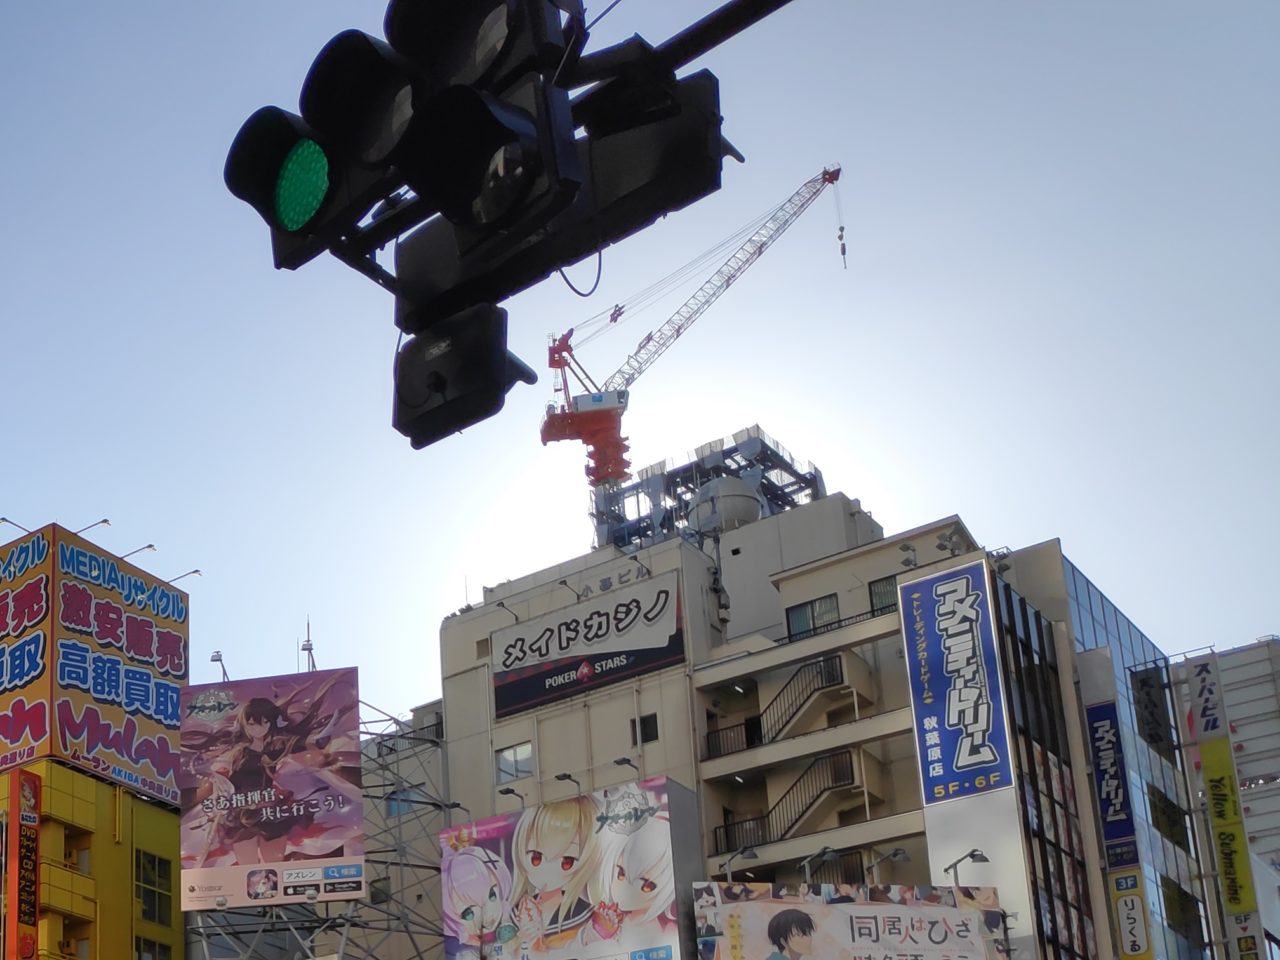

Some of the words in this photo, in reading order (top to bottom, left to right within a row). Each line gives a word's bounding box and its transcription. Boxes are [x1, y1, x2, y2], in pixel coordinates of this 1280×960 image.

[60, 581, 184, 675] 激安販売
[502, 590, 670, 670] メイドカジノ
[57, 640, 181, 728] 高額買取
[545, 671, 577, 689] POKER
[594, 654, 628, 674] STARS
[923, 716, 944, 778] 秋葉原店
[112, 765, 140, 786] AKIBA
[1208, 775, 1228, 821] Yellow
[201, 788, 285, 814] さあ指揮官、
[286, 870, 317, 880] アズレン
[1118, 877, 1136, 889] 3F
[1218, 831, 1242, 905] Submarine
